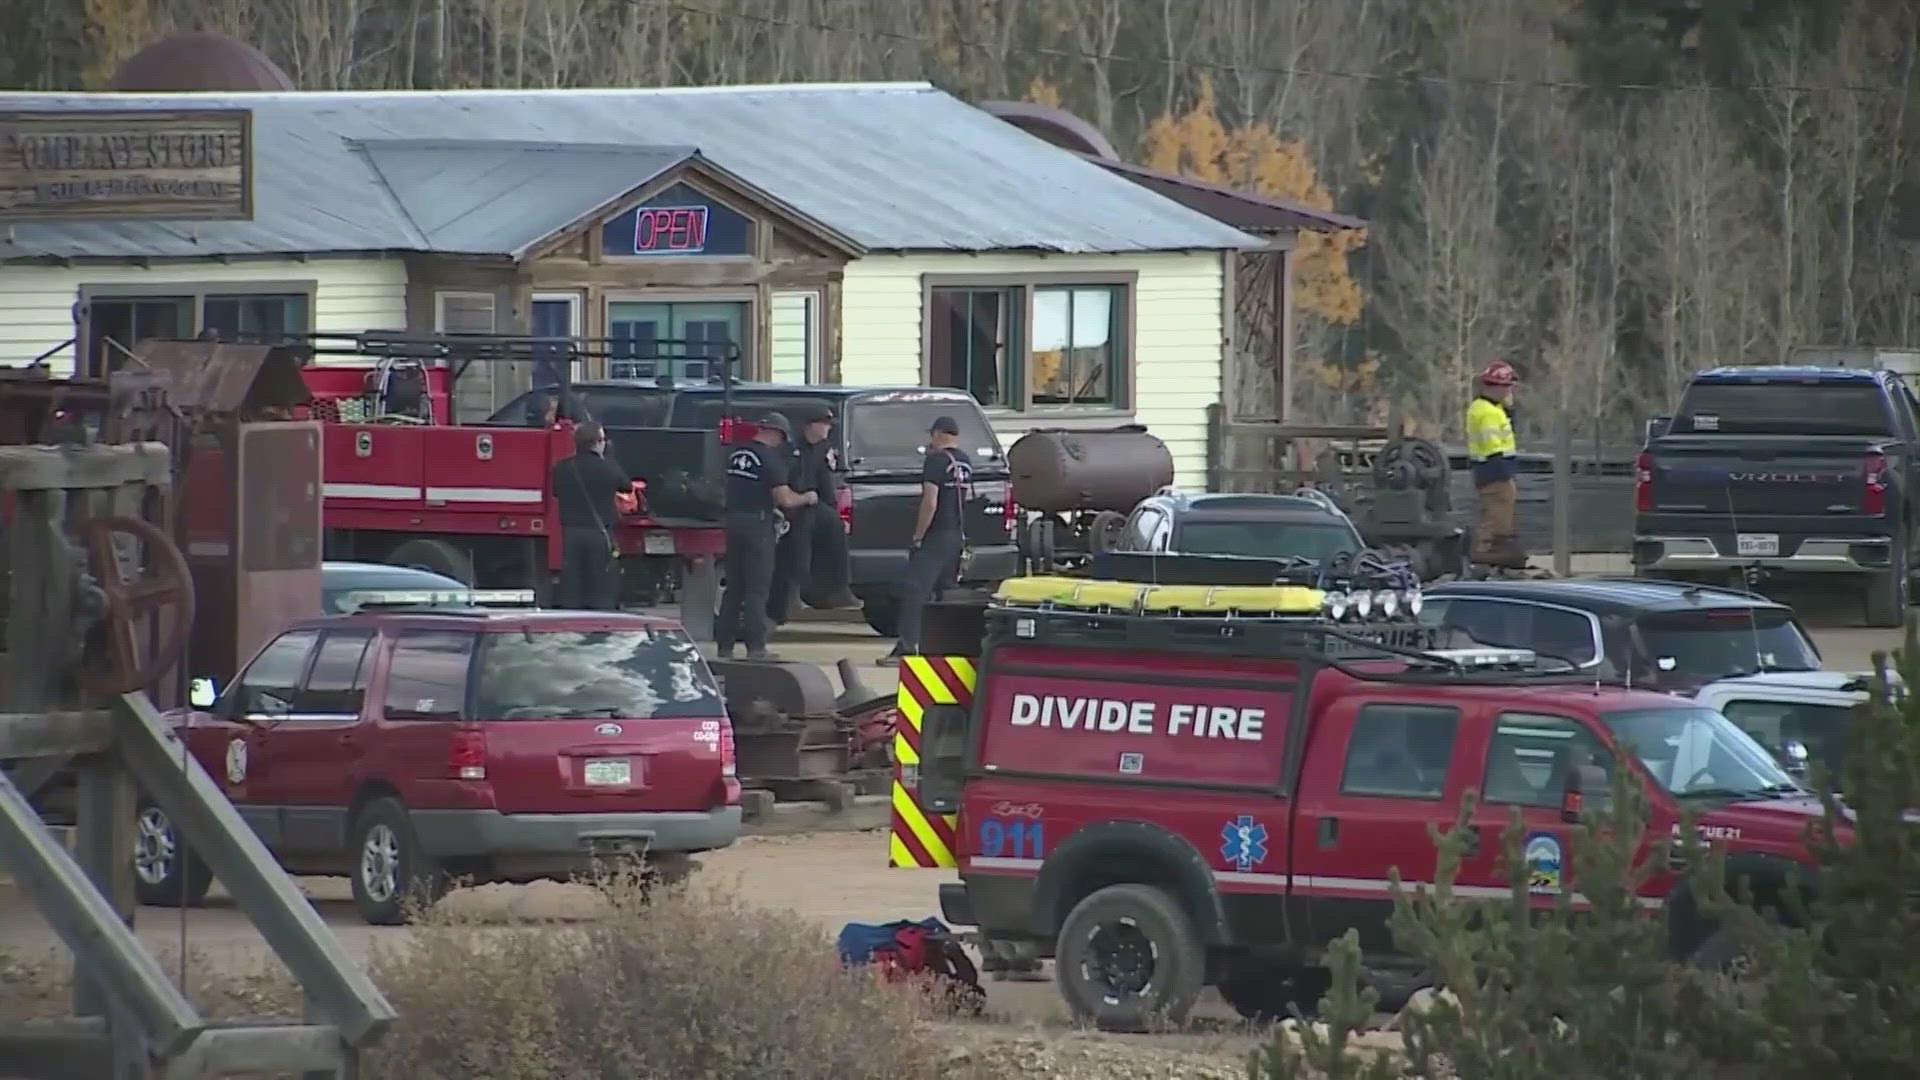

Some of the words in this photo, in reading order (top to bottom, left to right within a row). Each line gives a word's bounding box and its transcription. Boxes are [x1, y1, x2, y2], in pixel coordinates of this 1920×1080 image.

[638, 211, 704, 249] OPEN
[1010, 694, 1155, 734] DIVIDE
[1167, 704, 1265, 740] FIRE
[980, 818, 1043, 859] 911
